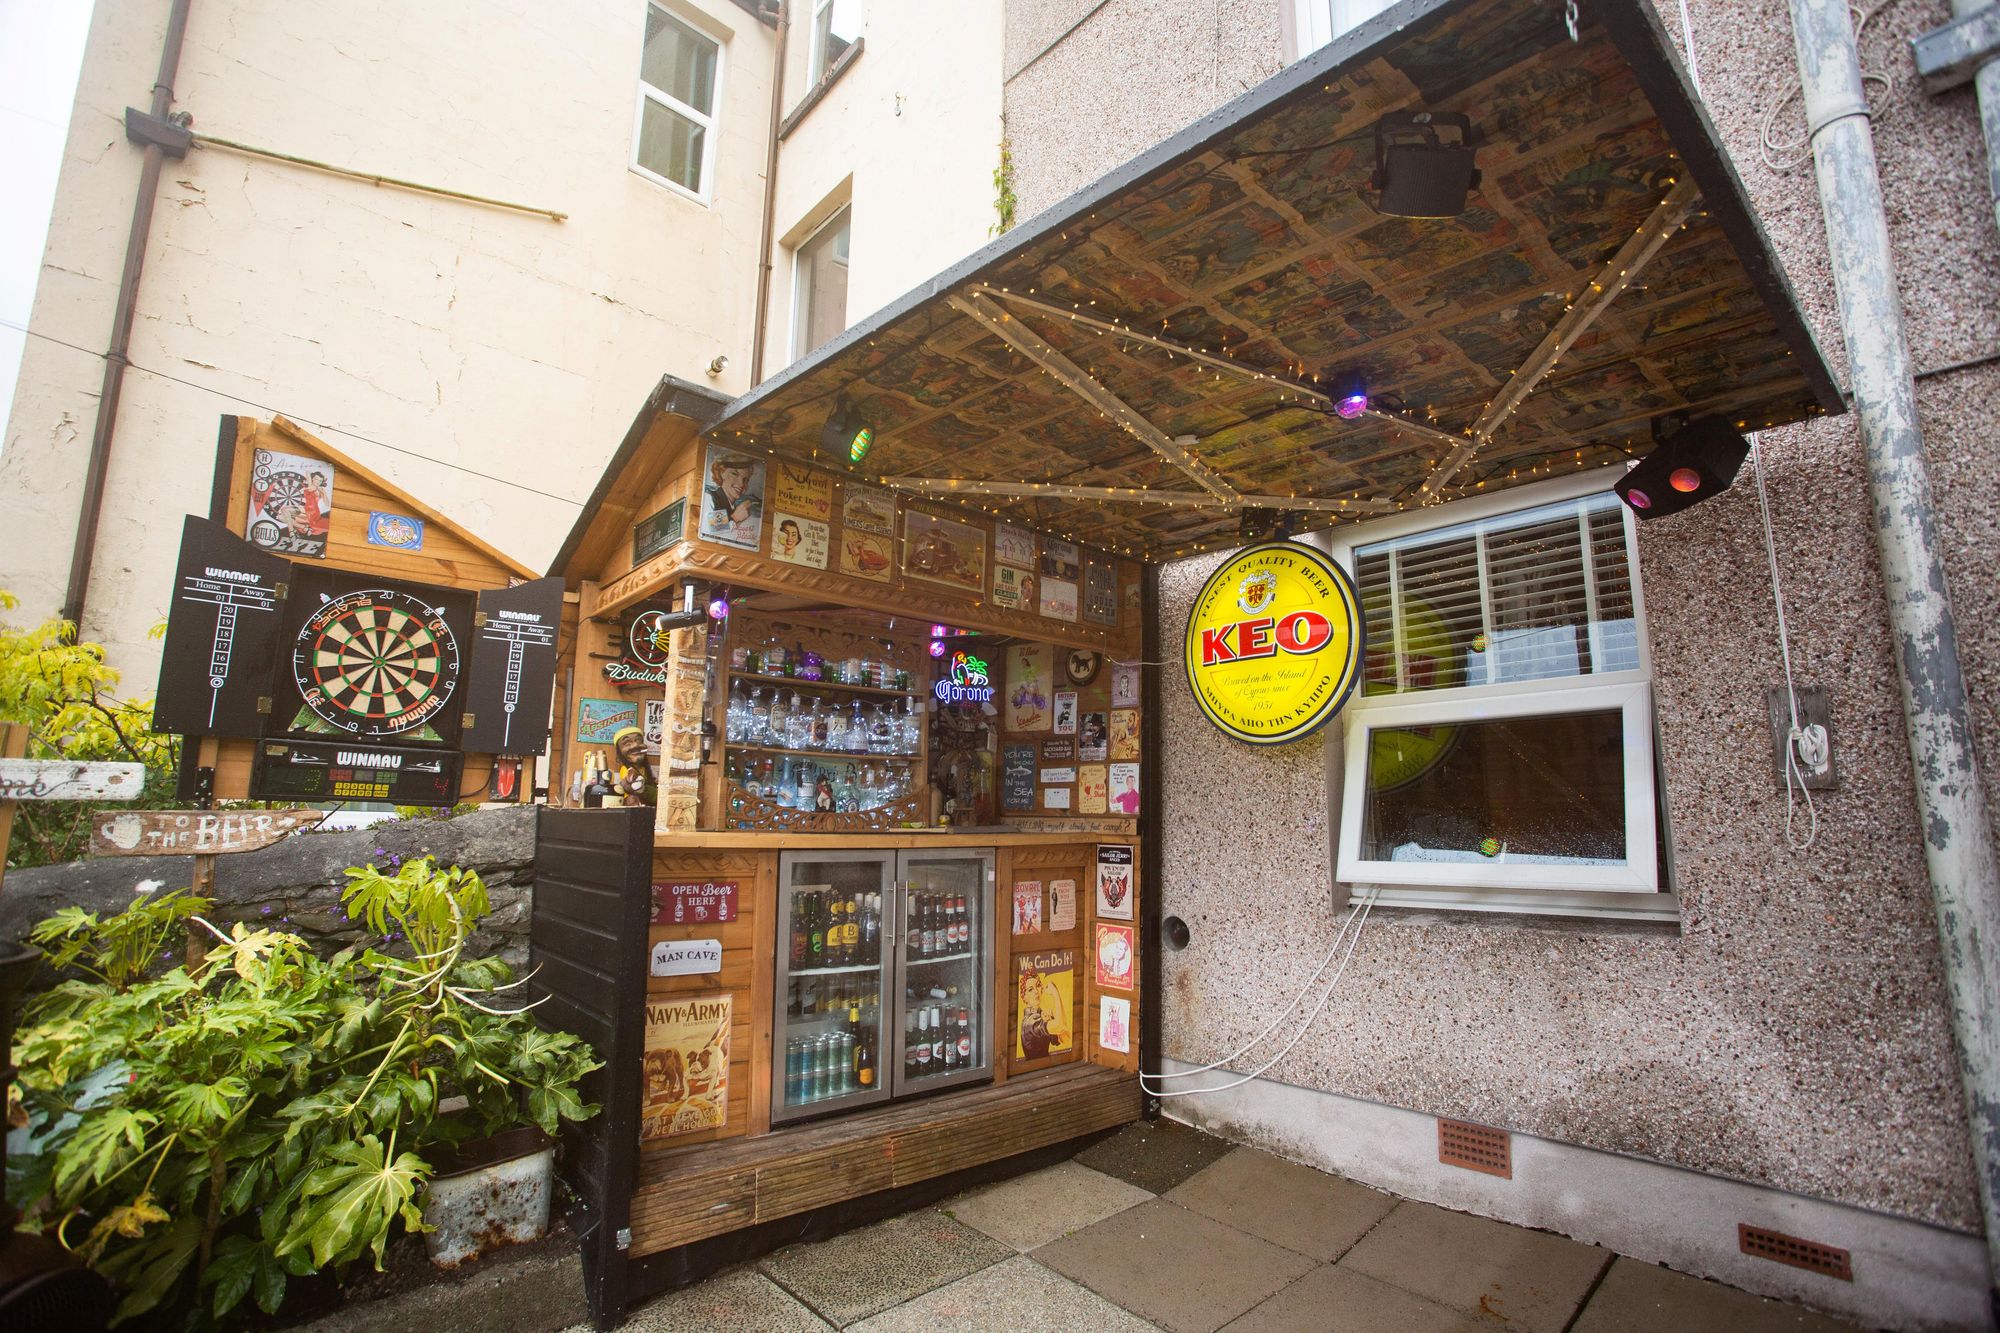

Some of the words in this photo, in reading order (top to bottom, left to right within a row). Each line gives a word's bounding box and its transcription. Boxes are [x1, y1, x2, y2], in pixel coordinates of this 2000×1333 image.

[778, 489, 802, 502] Poker
[254, 526, 280, 541] BULLS
[275, 540, 326, 555] EYE
[1001, 568, 1015, 583] GIN
[196, 581, 222, 591] Home
[243, 588, 266, 598] Away
[1202, 573, 1233, 618] FINEST
[1238, 556, 1298, 574] QUALITY
[1301, 566, 1331, 600] BEER
[379, 592, 394, 600] 20
[422, 607, 433, 617] 18
[492, 622, 512, 630] Home
[527, 626, 546, 635] Away
[218, 642, 228, 650] 17
[1201, 610, 1334, 667] KEO
[214, 666, 224, 674] 15
[605, 662, 666, 683] Budwe
[1221, 674, 1250, 687] Brewed
[1261, 672, 1272, 682] the
[1277, 667, 1307, 680] Island
[935, 679, 990, 704] Corona
[647, 702, 664, 719] TIK
[336, 751, 402, 769] WINMAU
[1005, 778, 1014, 786] IN
[1014, 787, 1034, 797] SEA
[155, 814, 190, 828] TO
[147, 831, 190, 848] THE
[193, 814, 273, 850] BEER
[672, 885, 699, 895] OPEN
[701, 883, 733, 896] Beer
[1015, 883, 1040, 893] BOVRIL
[688, 896, 716, 906] HERE
[657, 951, 683, 965] MAN
[687, 950, 719, 961] CAVE
[1020, 956, 1033, 971] We
[1034, 955, 1050, 969] Can
[1051, 953, 1063, 967] Do
[1064, 951, 1073, 965] It!
[646, 1005, 683, 1026] NAVY
[687, 1002, 729, 1022] ARMY
[683, 1118, 710, 1131] HOLD
